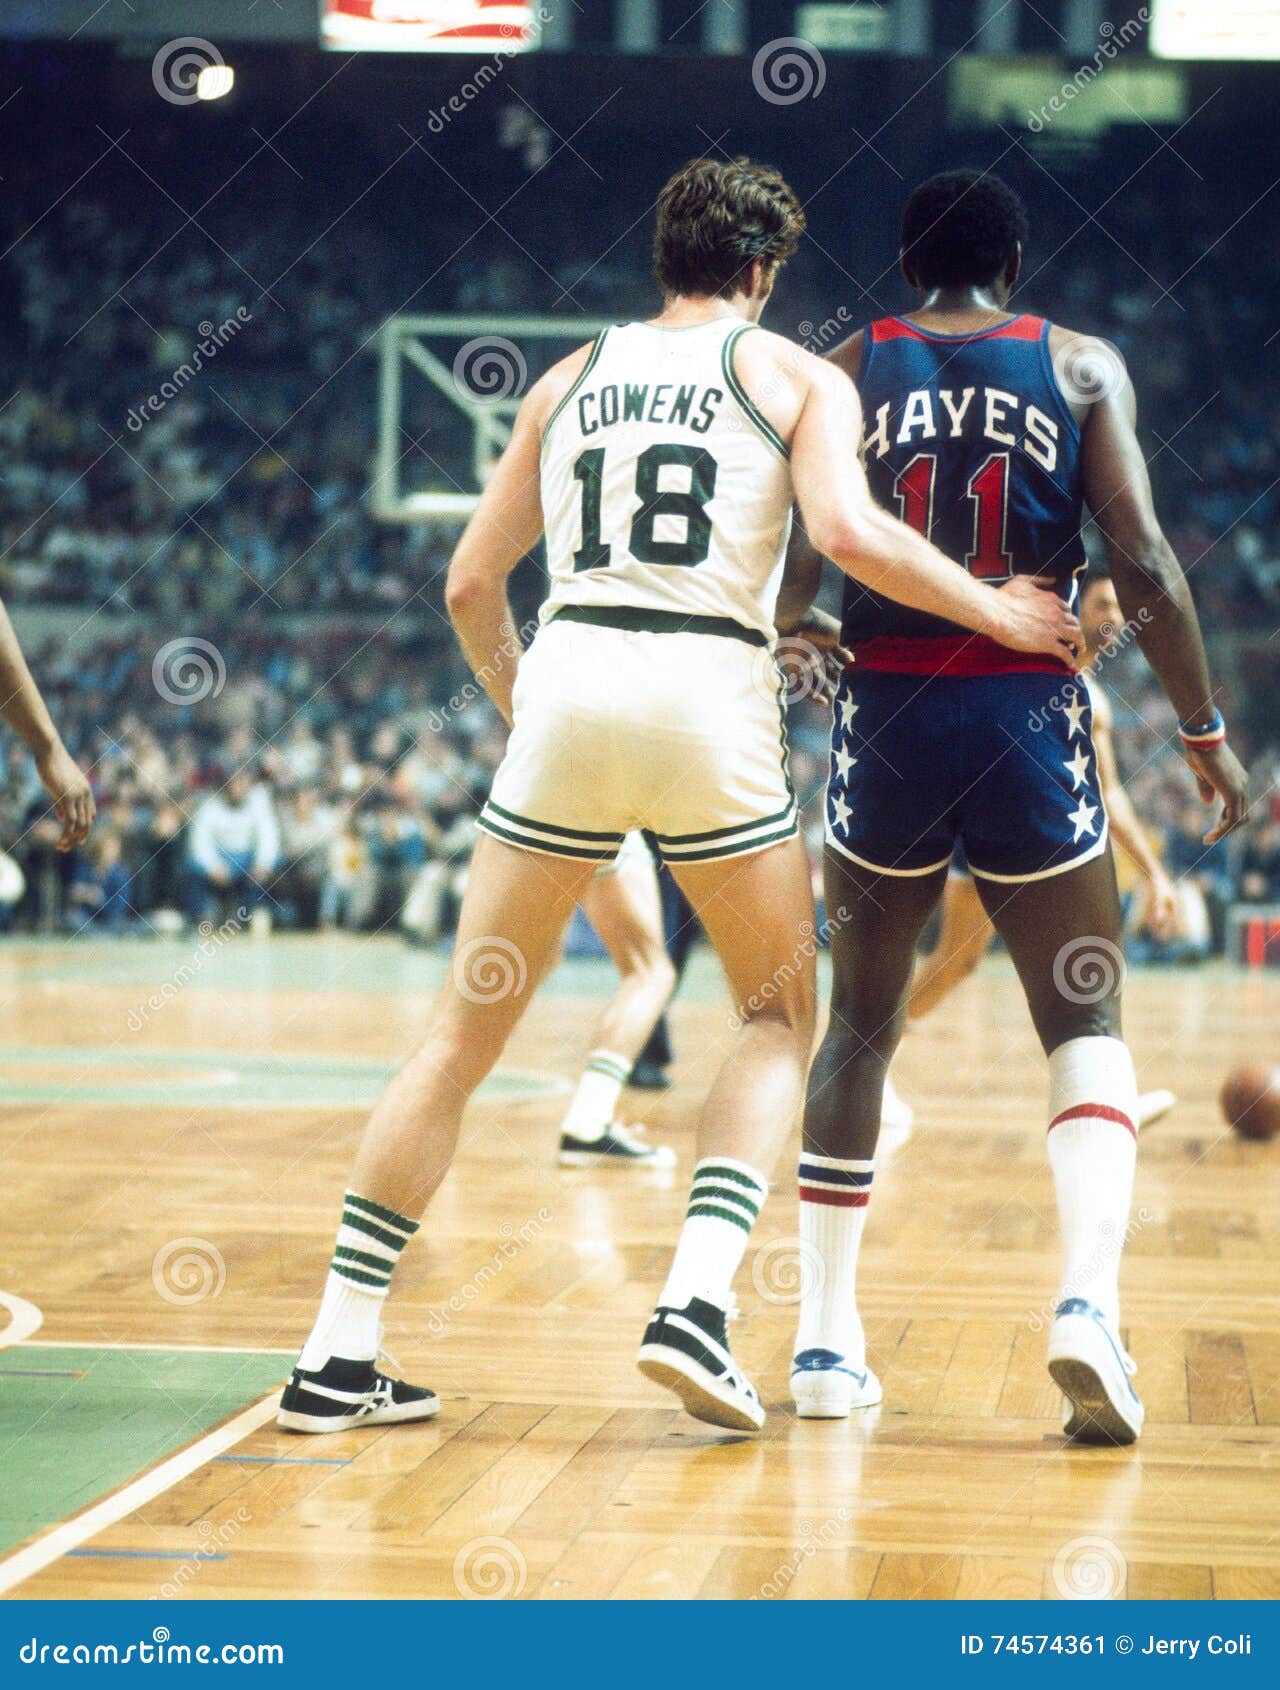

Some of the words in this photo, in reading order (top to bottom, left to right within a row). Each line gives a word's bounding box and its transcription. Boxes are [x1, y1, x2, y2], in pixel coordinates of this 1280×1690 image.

[578, 384, 723, 436] COWENS
[858, 387, 1058, 472] HAYES
[573, 443, 718, 573] 18
[893, 452, 1013, 581] 11
